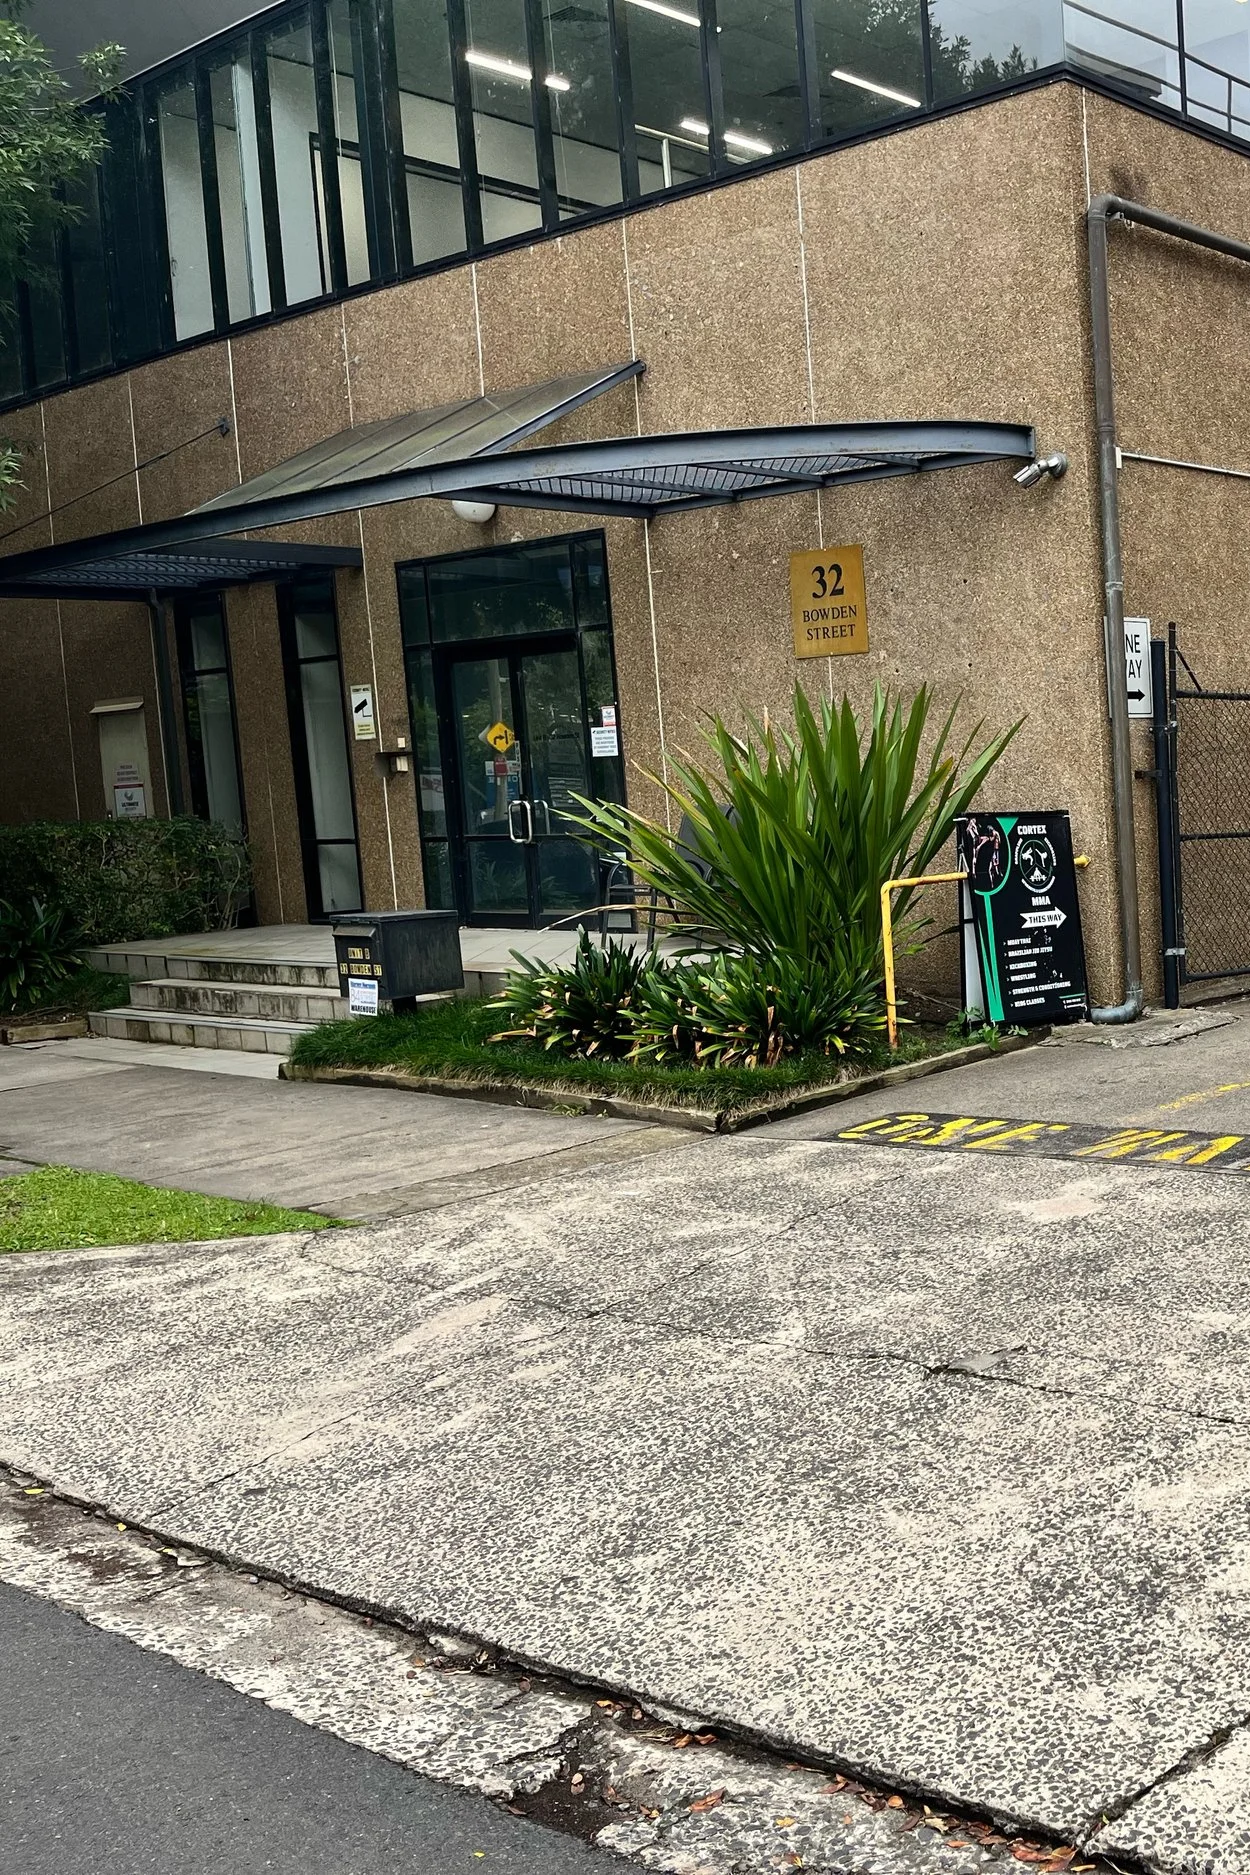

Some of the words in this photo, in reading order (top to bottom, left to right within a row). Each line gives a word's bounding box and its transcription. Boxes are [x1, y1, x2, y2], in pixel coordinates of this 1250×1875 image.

[811, 563, 845, 599] 32
[802, 605, 857, 623] BOWDEN
[806, 624, 856, 641] STREET
[1125, 633, 1141, 653] NE
[1127, 659, 1142, 679] AY
[1017, 825, 1047, 835] CORTEX
[1031, 896, 1051, 907] MMA
[1029, 915, 1046, 924] THIS
[1046, 914, 1062, 923] WAY
[348, 948, 363, 959] UNIT
[349, 964, 372, 975] BOWDEN
[373, 964, 382, 976] ST
[1026, 997, 1046, 1005] CLASSES
[350, 1004, 377, 1014] WAREHOUSE
[836, 1113, 1072, 1150] ONE
